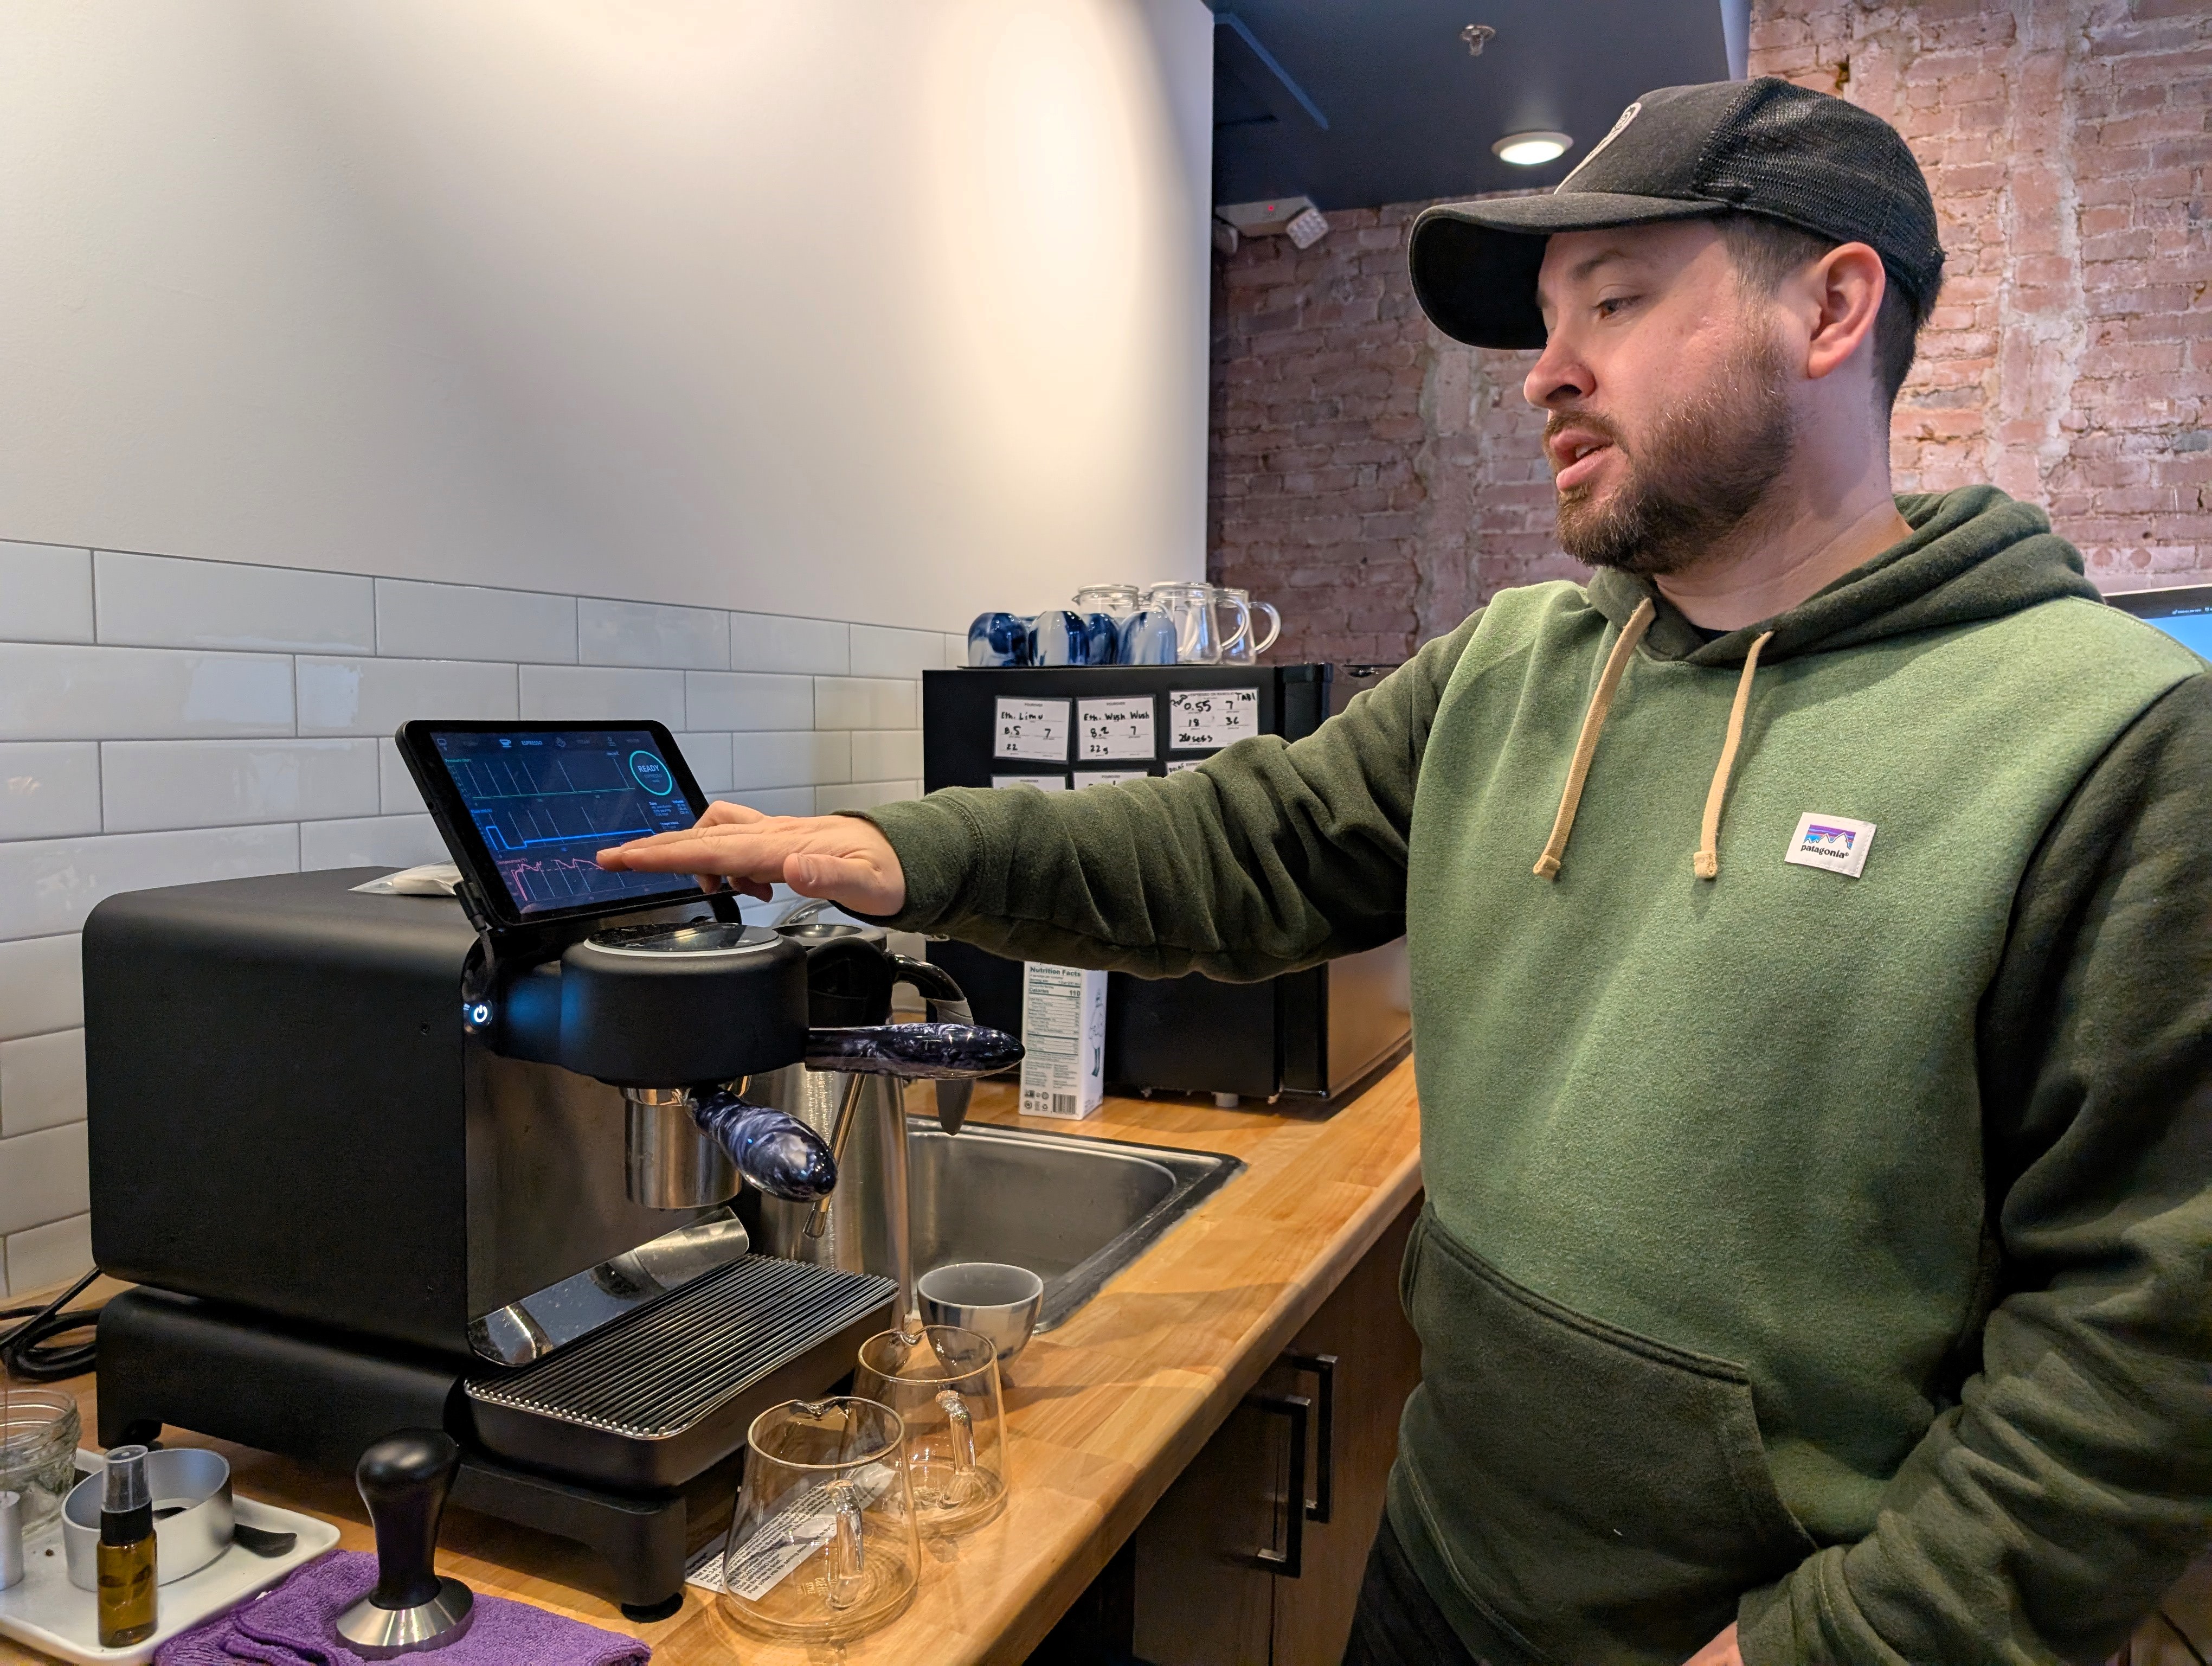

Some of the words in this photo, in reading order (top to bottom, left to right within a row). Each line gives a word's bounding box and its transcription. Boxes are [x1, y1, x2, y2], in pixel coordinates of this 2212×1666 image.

[1184, 700, 1211, 712] 0.55
[1225, 701, 1233, 710] 7
[1045, 728, 1051, 738] 7
[1130, 726, 1136, 735] 7
[1030, 966, 1060, 975] Nutrition
[806, 1582, 815, 1594] STYLE
